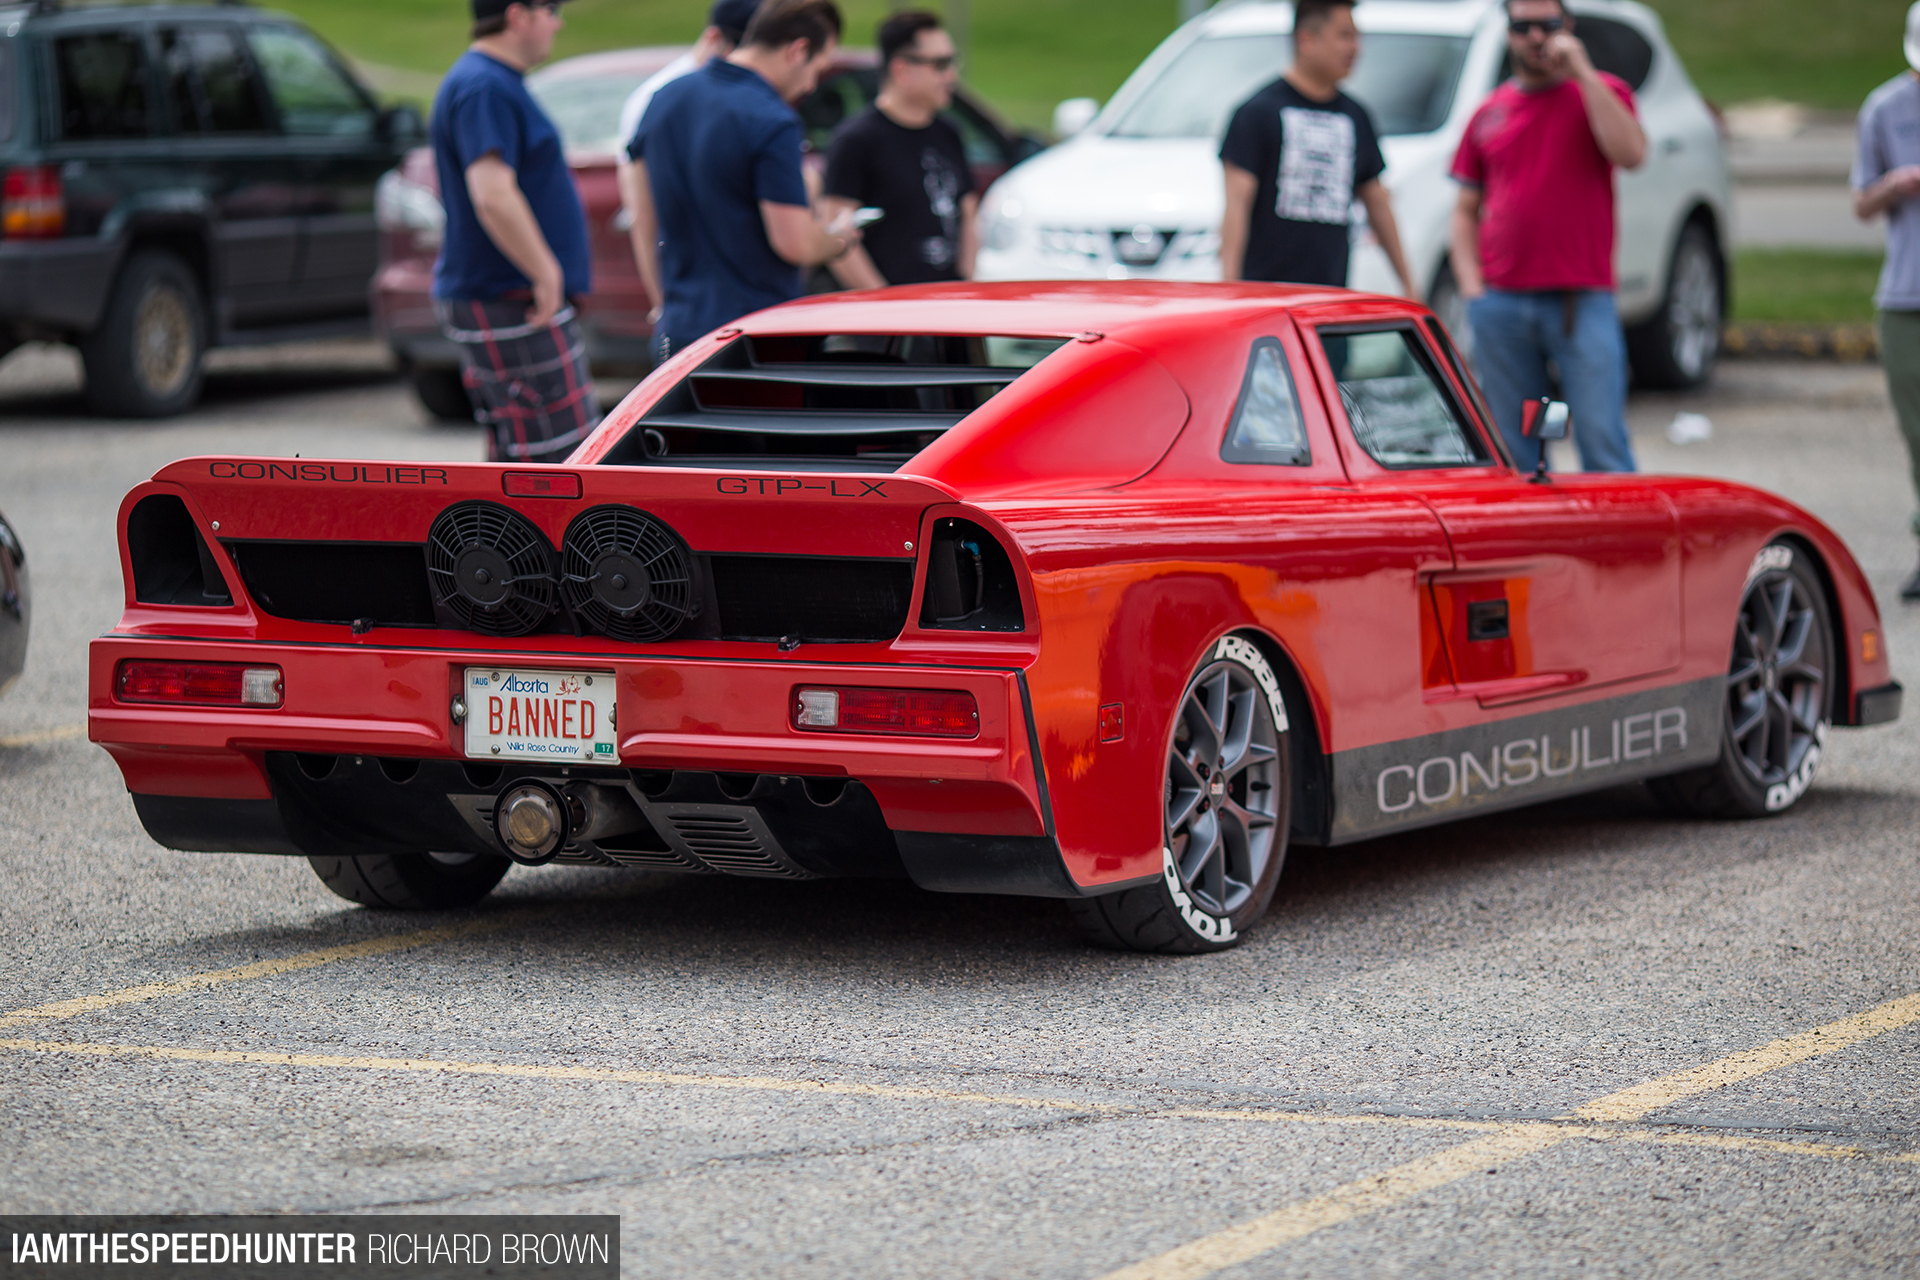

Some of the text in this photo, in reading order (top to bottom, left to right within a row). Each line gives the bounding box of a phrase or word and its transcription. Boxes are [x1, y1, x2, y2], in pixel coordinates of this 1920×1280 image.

[209, 462, 448, 485] CONSULIER
[716, 477, 889, 498] GTP-LX
[475, 676, 489, 686] AUG
[500, 673, 549, 694] Alberta
[488, 695, 595, 739] BANNED
[506, 741, 579, 754] Wild Rose Country
[601, 744, 611, 753] 17
[1376, 705, 1688, 814] CONSULIER
[1162, 846, 1237, 942] TOYO
